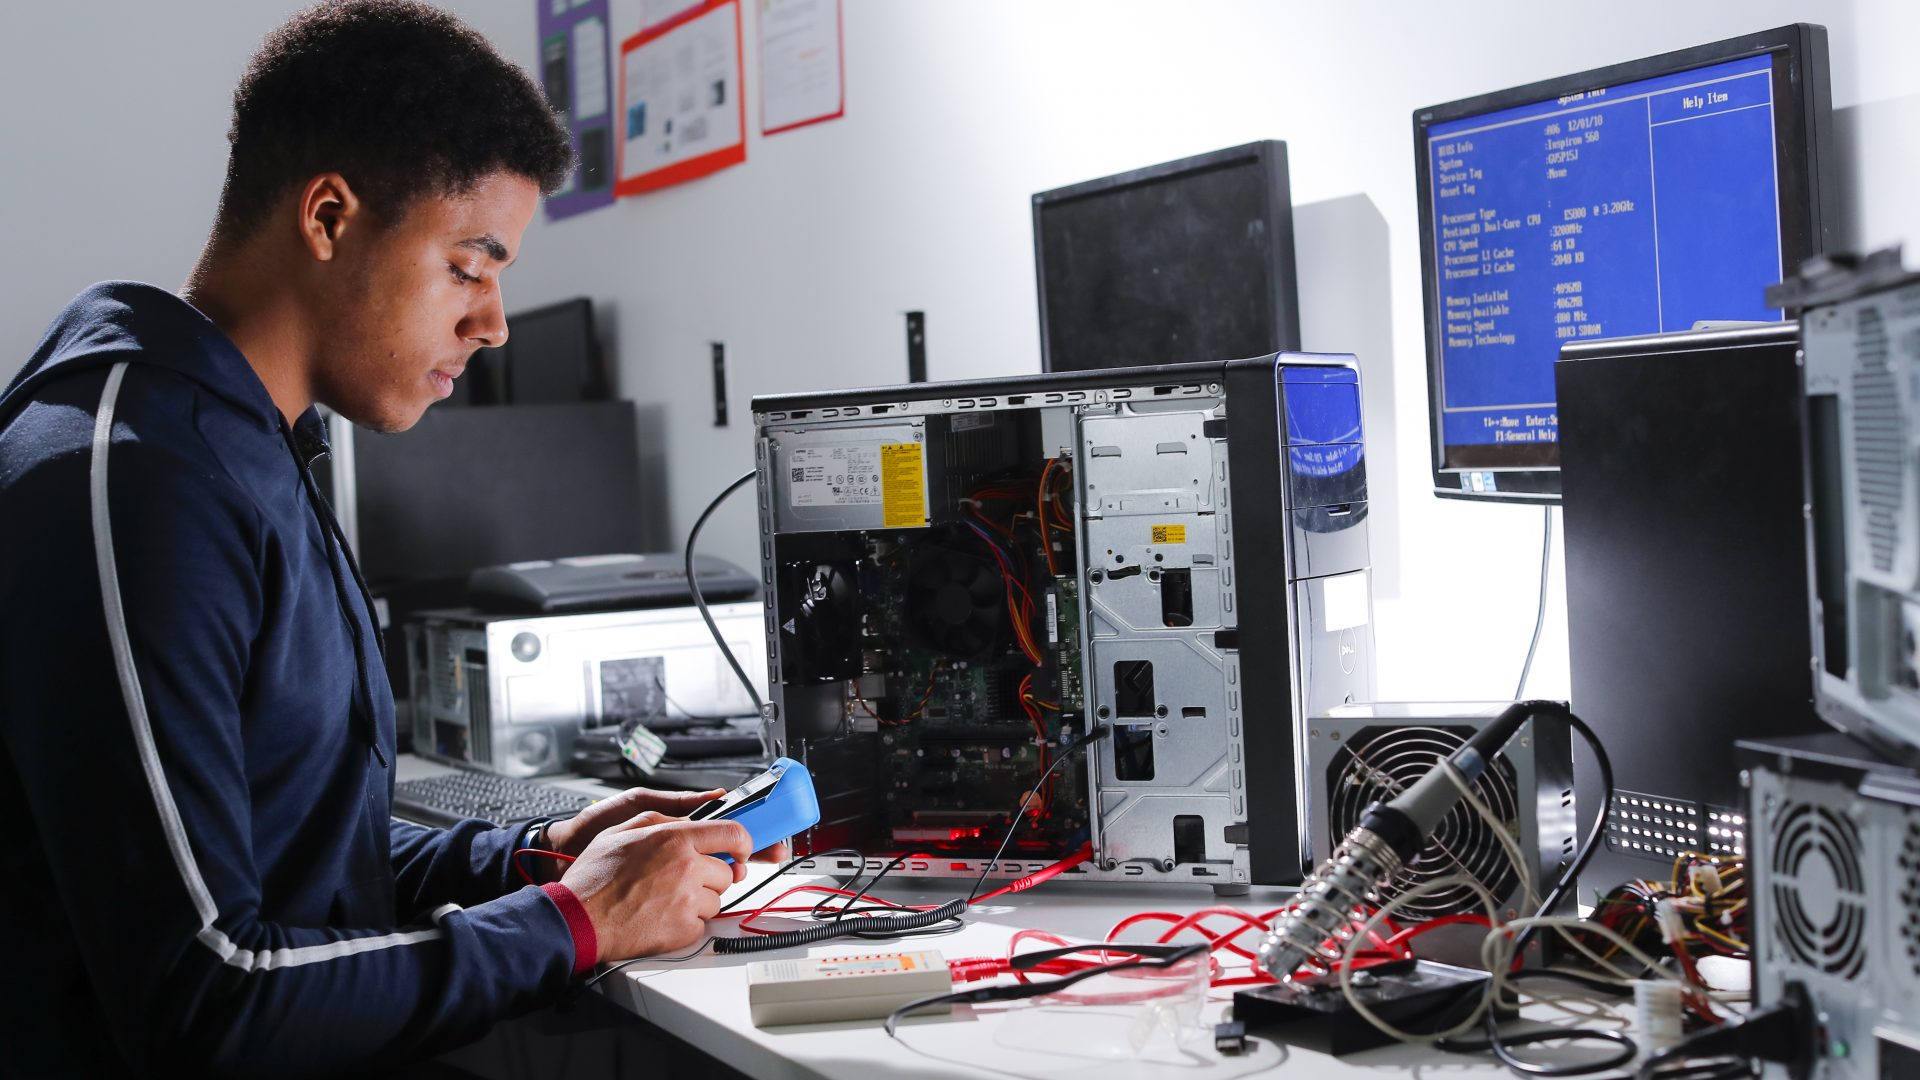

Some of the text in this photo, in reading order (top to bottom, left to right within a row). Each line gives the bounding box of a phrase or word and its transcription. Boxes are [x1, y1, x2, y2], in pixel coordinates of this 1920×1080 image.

[1683, 92, 1728, 109] Help Item
[1457, 141, 1474, 153] Info
[1567, 114, 1603, 132] 12/01/10
[1439, 158, 1463, 171] System
[1585, 131, 1599, 144] 560
[1440, 172, 1467, 184] Service
[1469, 168, 1483, 180] Tag
[1440, 186, 1461, 198] Asset
[1463, 183, 1476, 195] Tag
[1442, 212, 1476, 225] Processor
[1480, 208, 1496, 220] Type
[1484, 219, 1520, 232] Dual-Core
[1527, 214, 1541, 226] CPU
[1593, 205, 1600, 216] @
[1602, 200, 1634, 215] 3.20GHz
[1443, 240, 1456, 252] CPU
[1458, 238, 1478, 252] Speed
[1444, 254, 1478, 266] Processor
[1482, 250, 1490, 261] L1
[1493, 247, 1514, 260] Cache
[1566, 238, 1575, 250] KB
[1445, 268, 1479, 280] Processor
[1483, 264, 1492, 275] L2
[1494, 261, 1516, 273] Cache
[1575, 251, 1584, 264] KB
[1446, 296, 1471, 307] Memory
[1473, 289, 1509, 304] Installed
[1447, 310, 1472, 321] Memory
[1473, 304, 1510, 318] Available
[1448, 323, 1472, 334] Memory
[1473, 319, 1494, 334] Speed
[1573, 310, 1588, 322] MHz
[1448, 337, 1473, 348] Memory
[1475, 332, 1515, 346] Technology
[1495, 428, 1556, 442] F1:General Help
